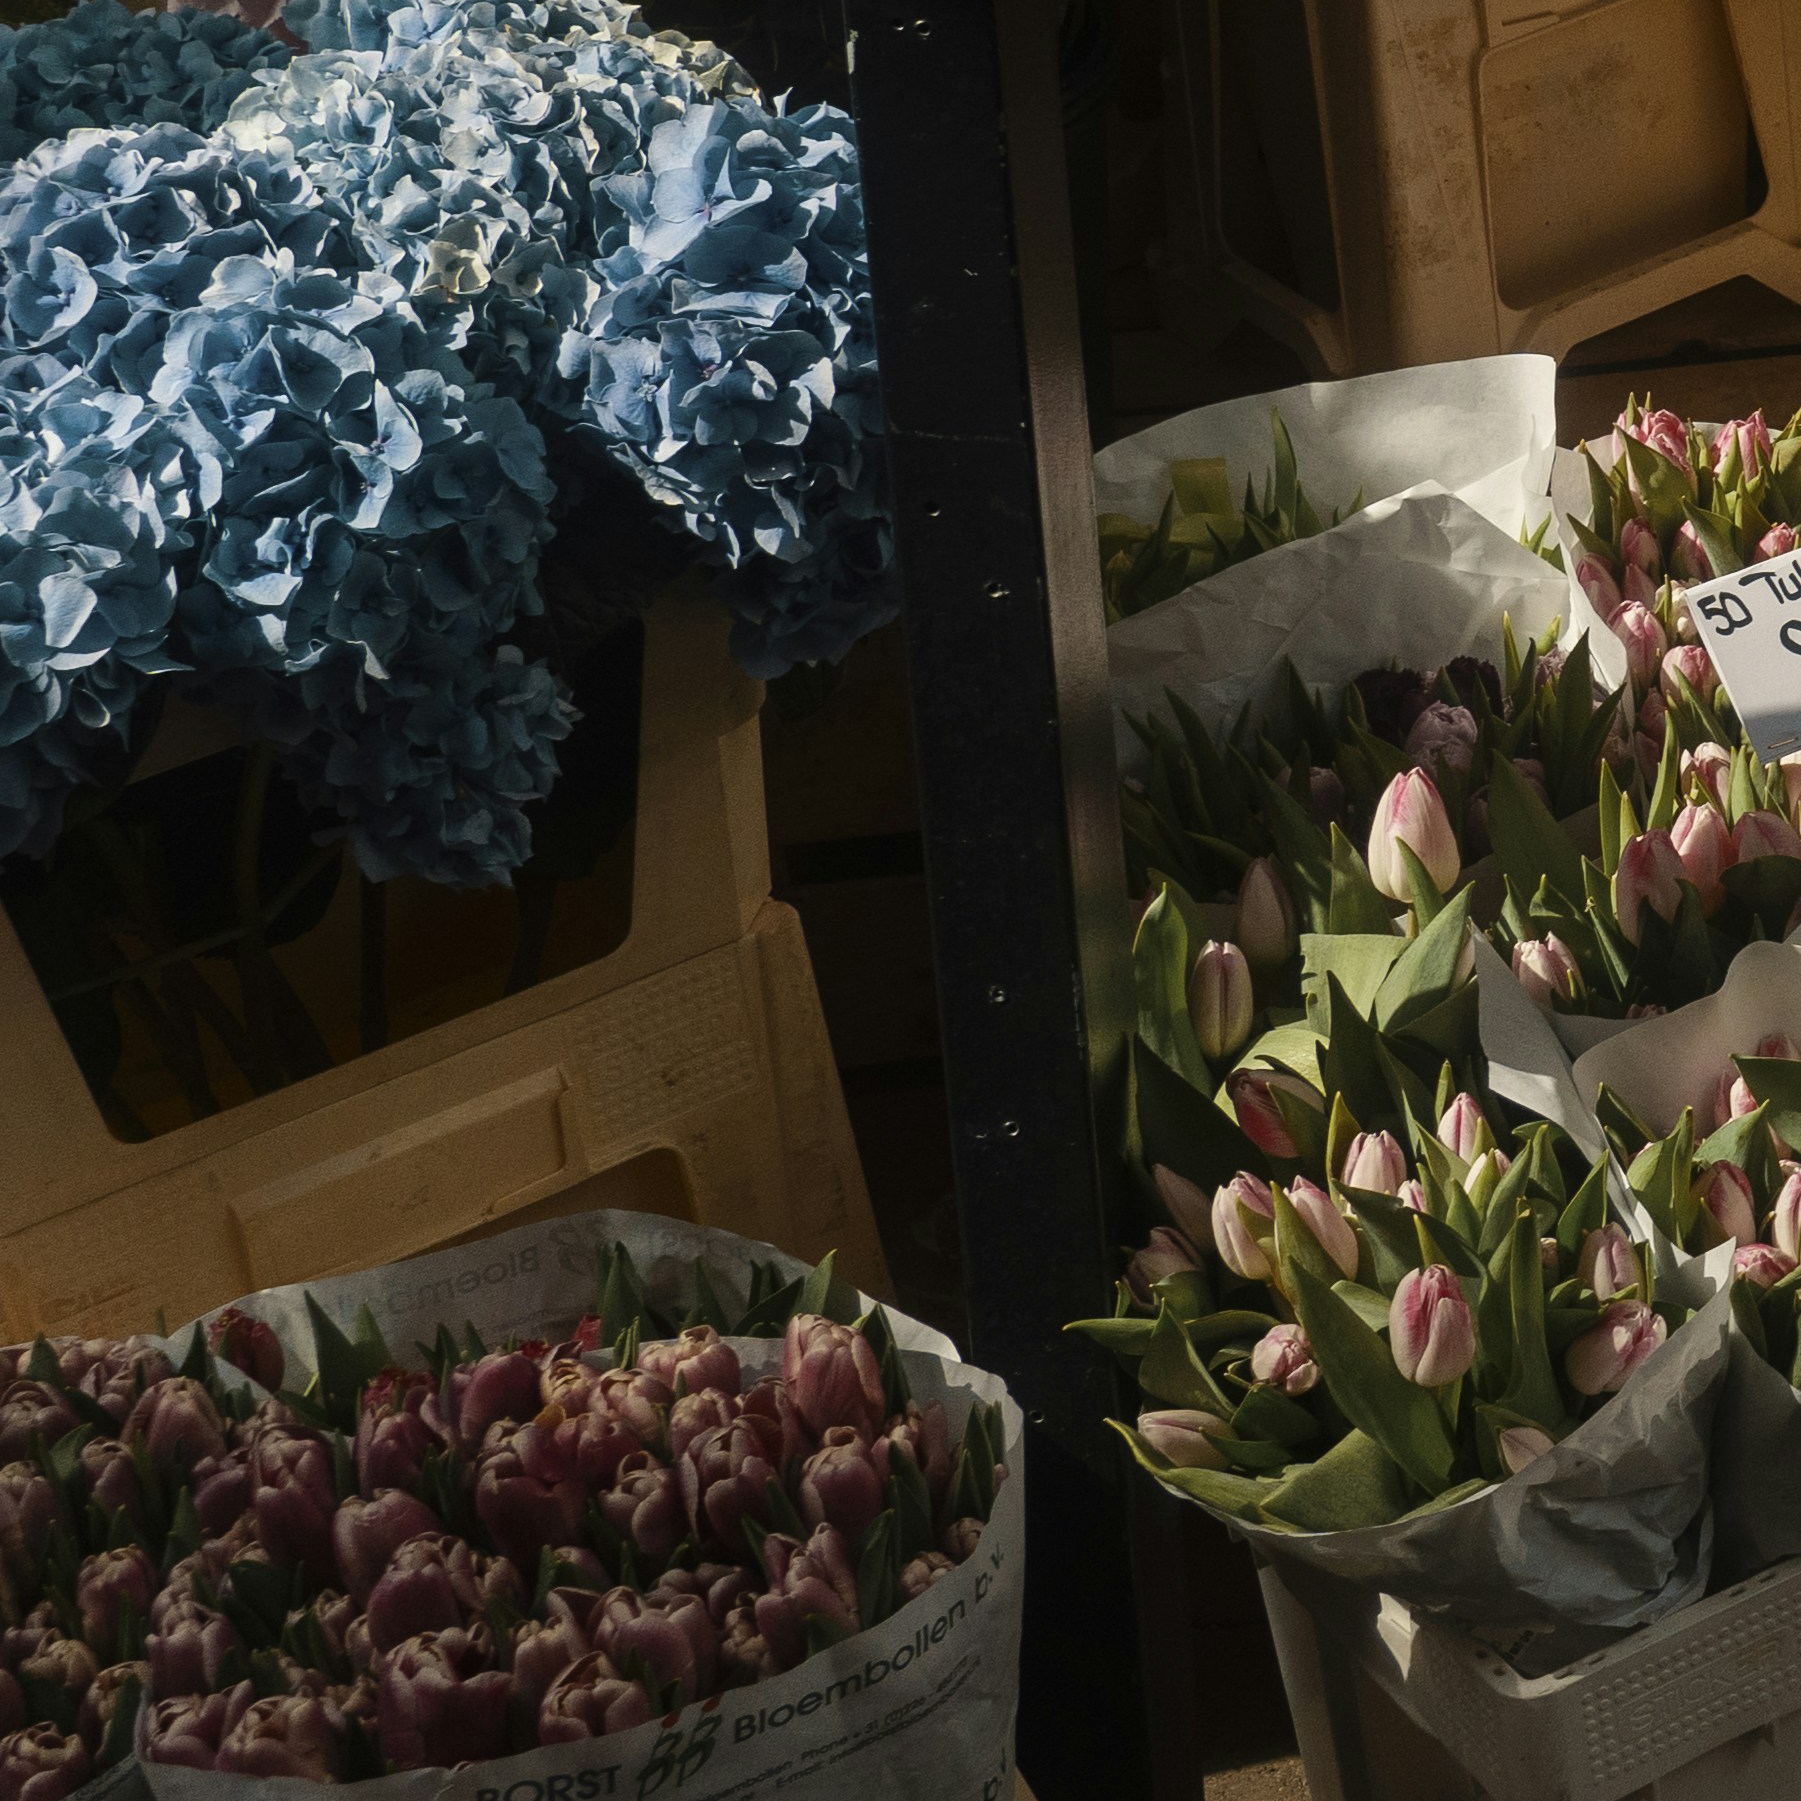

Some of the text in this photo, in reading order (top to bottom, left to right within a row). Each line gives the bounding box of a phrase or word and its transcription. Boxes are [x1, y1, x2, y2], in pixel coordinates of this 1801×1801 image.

[1697, 592, 1753, 636] 50
[733, 1599, 967, 1744] Bloembollen
[1629, 1637, 1782, 1733] STICKER
